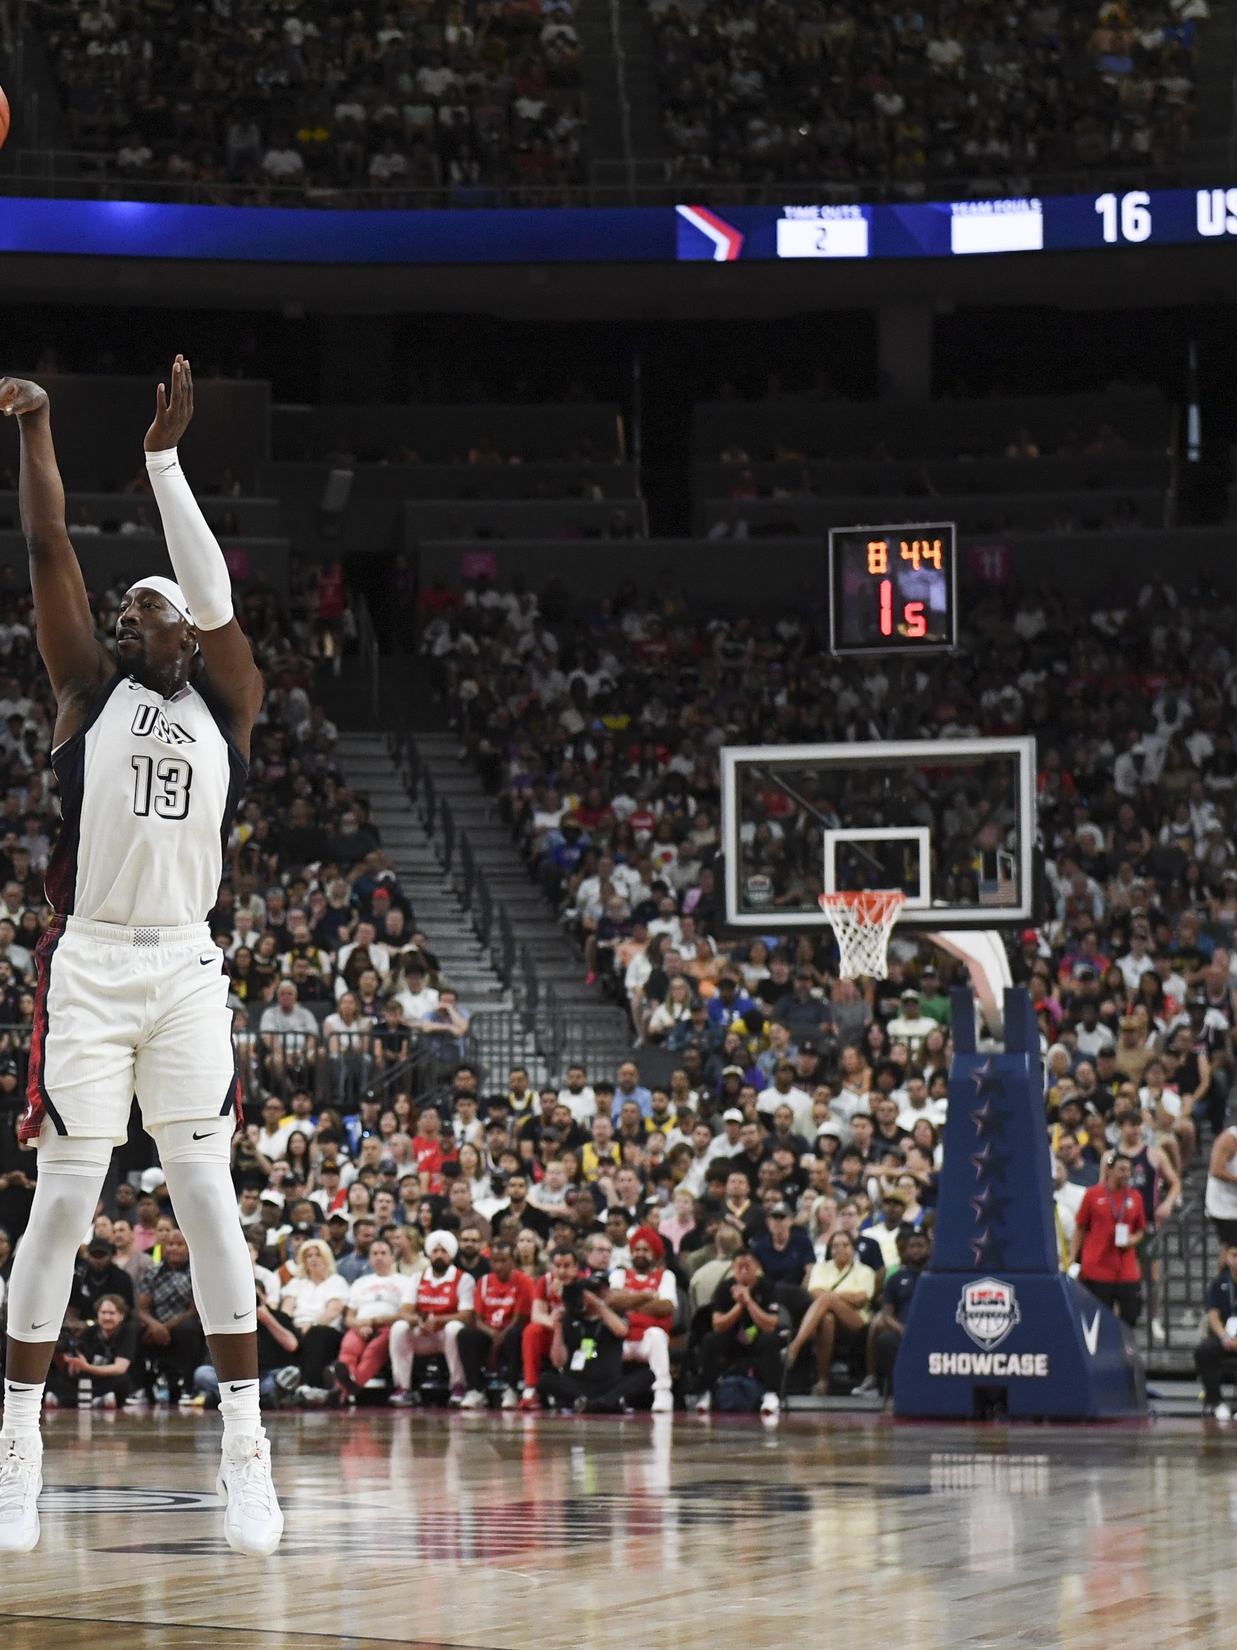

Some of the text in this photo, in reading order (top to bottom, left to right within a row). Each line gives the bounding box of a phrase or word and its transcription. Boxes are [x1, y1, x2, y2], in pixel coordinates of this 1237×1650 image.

[1095, 190, 1152, 243] 16
[131, 704, 197, 744] USA
[131, 755, 193, 820] 13
[928, 1352, 1049, 1377] SHOWCASE
